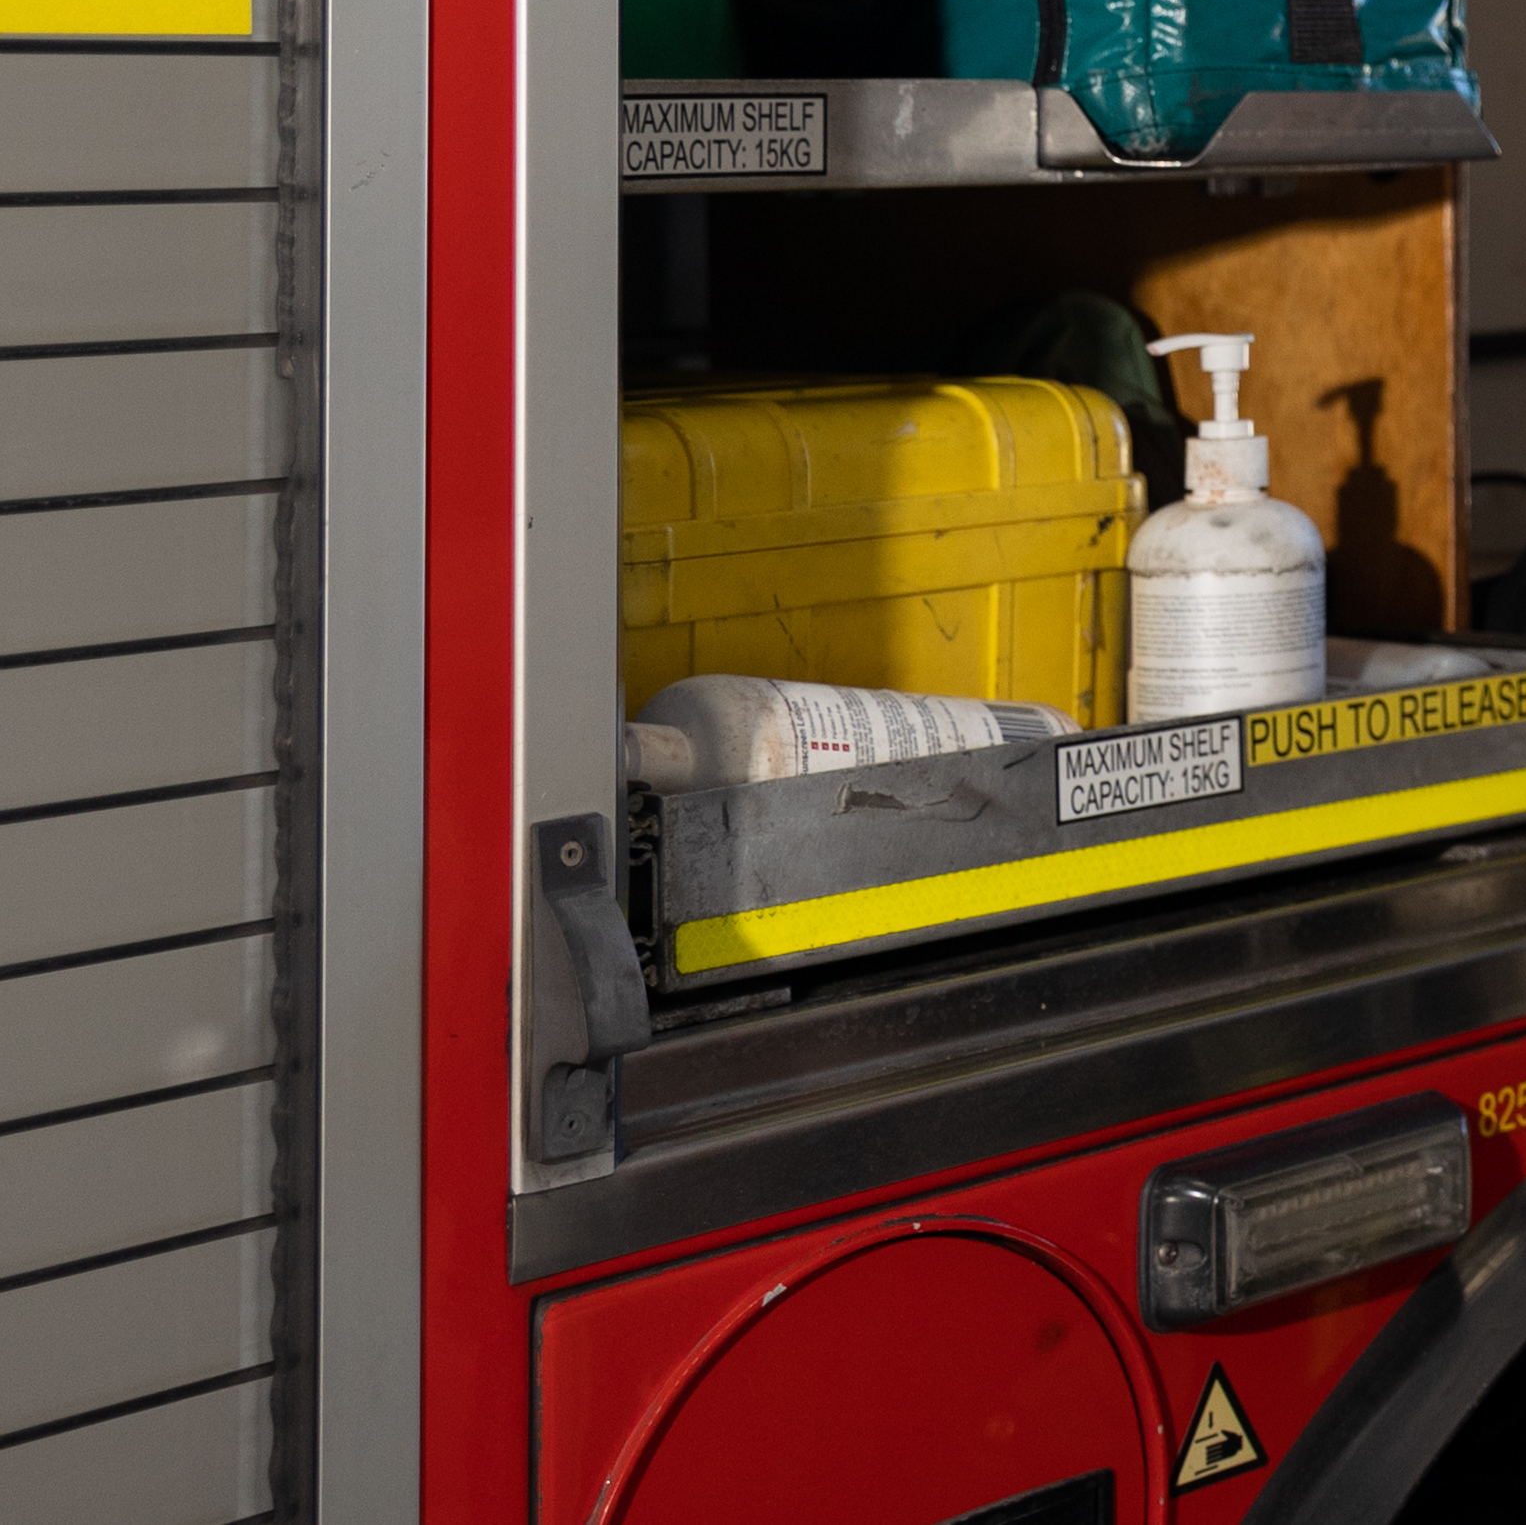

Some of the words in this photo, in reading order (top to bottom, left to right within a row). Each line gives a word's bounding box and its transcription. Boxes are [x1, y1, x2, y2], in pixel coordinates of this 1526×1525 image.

[623, 102, 736, 134] MAXIMUM
[742, 102, 815, 132] SHELF
[626, 138, 747, 172] CAPACITY:
[755, 137, 811, 169] 15KG
[1066, 736, 1164, 780] MAXIMUM
[1169, 725, 1231, 763] SHELF
[1251, 707, 1338, 763] PUSH
[1347, 698, 1390, 742] TO
[1071, 770, 1175, 815] CAPACITY:
[1182, 760, 1230, 795] 15KG
